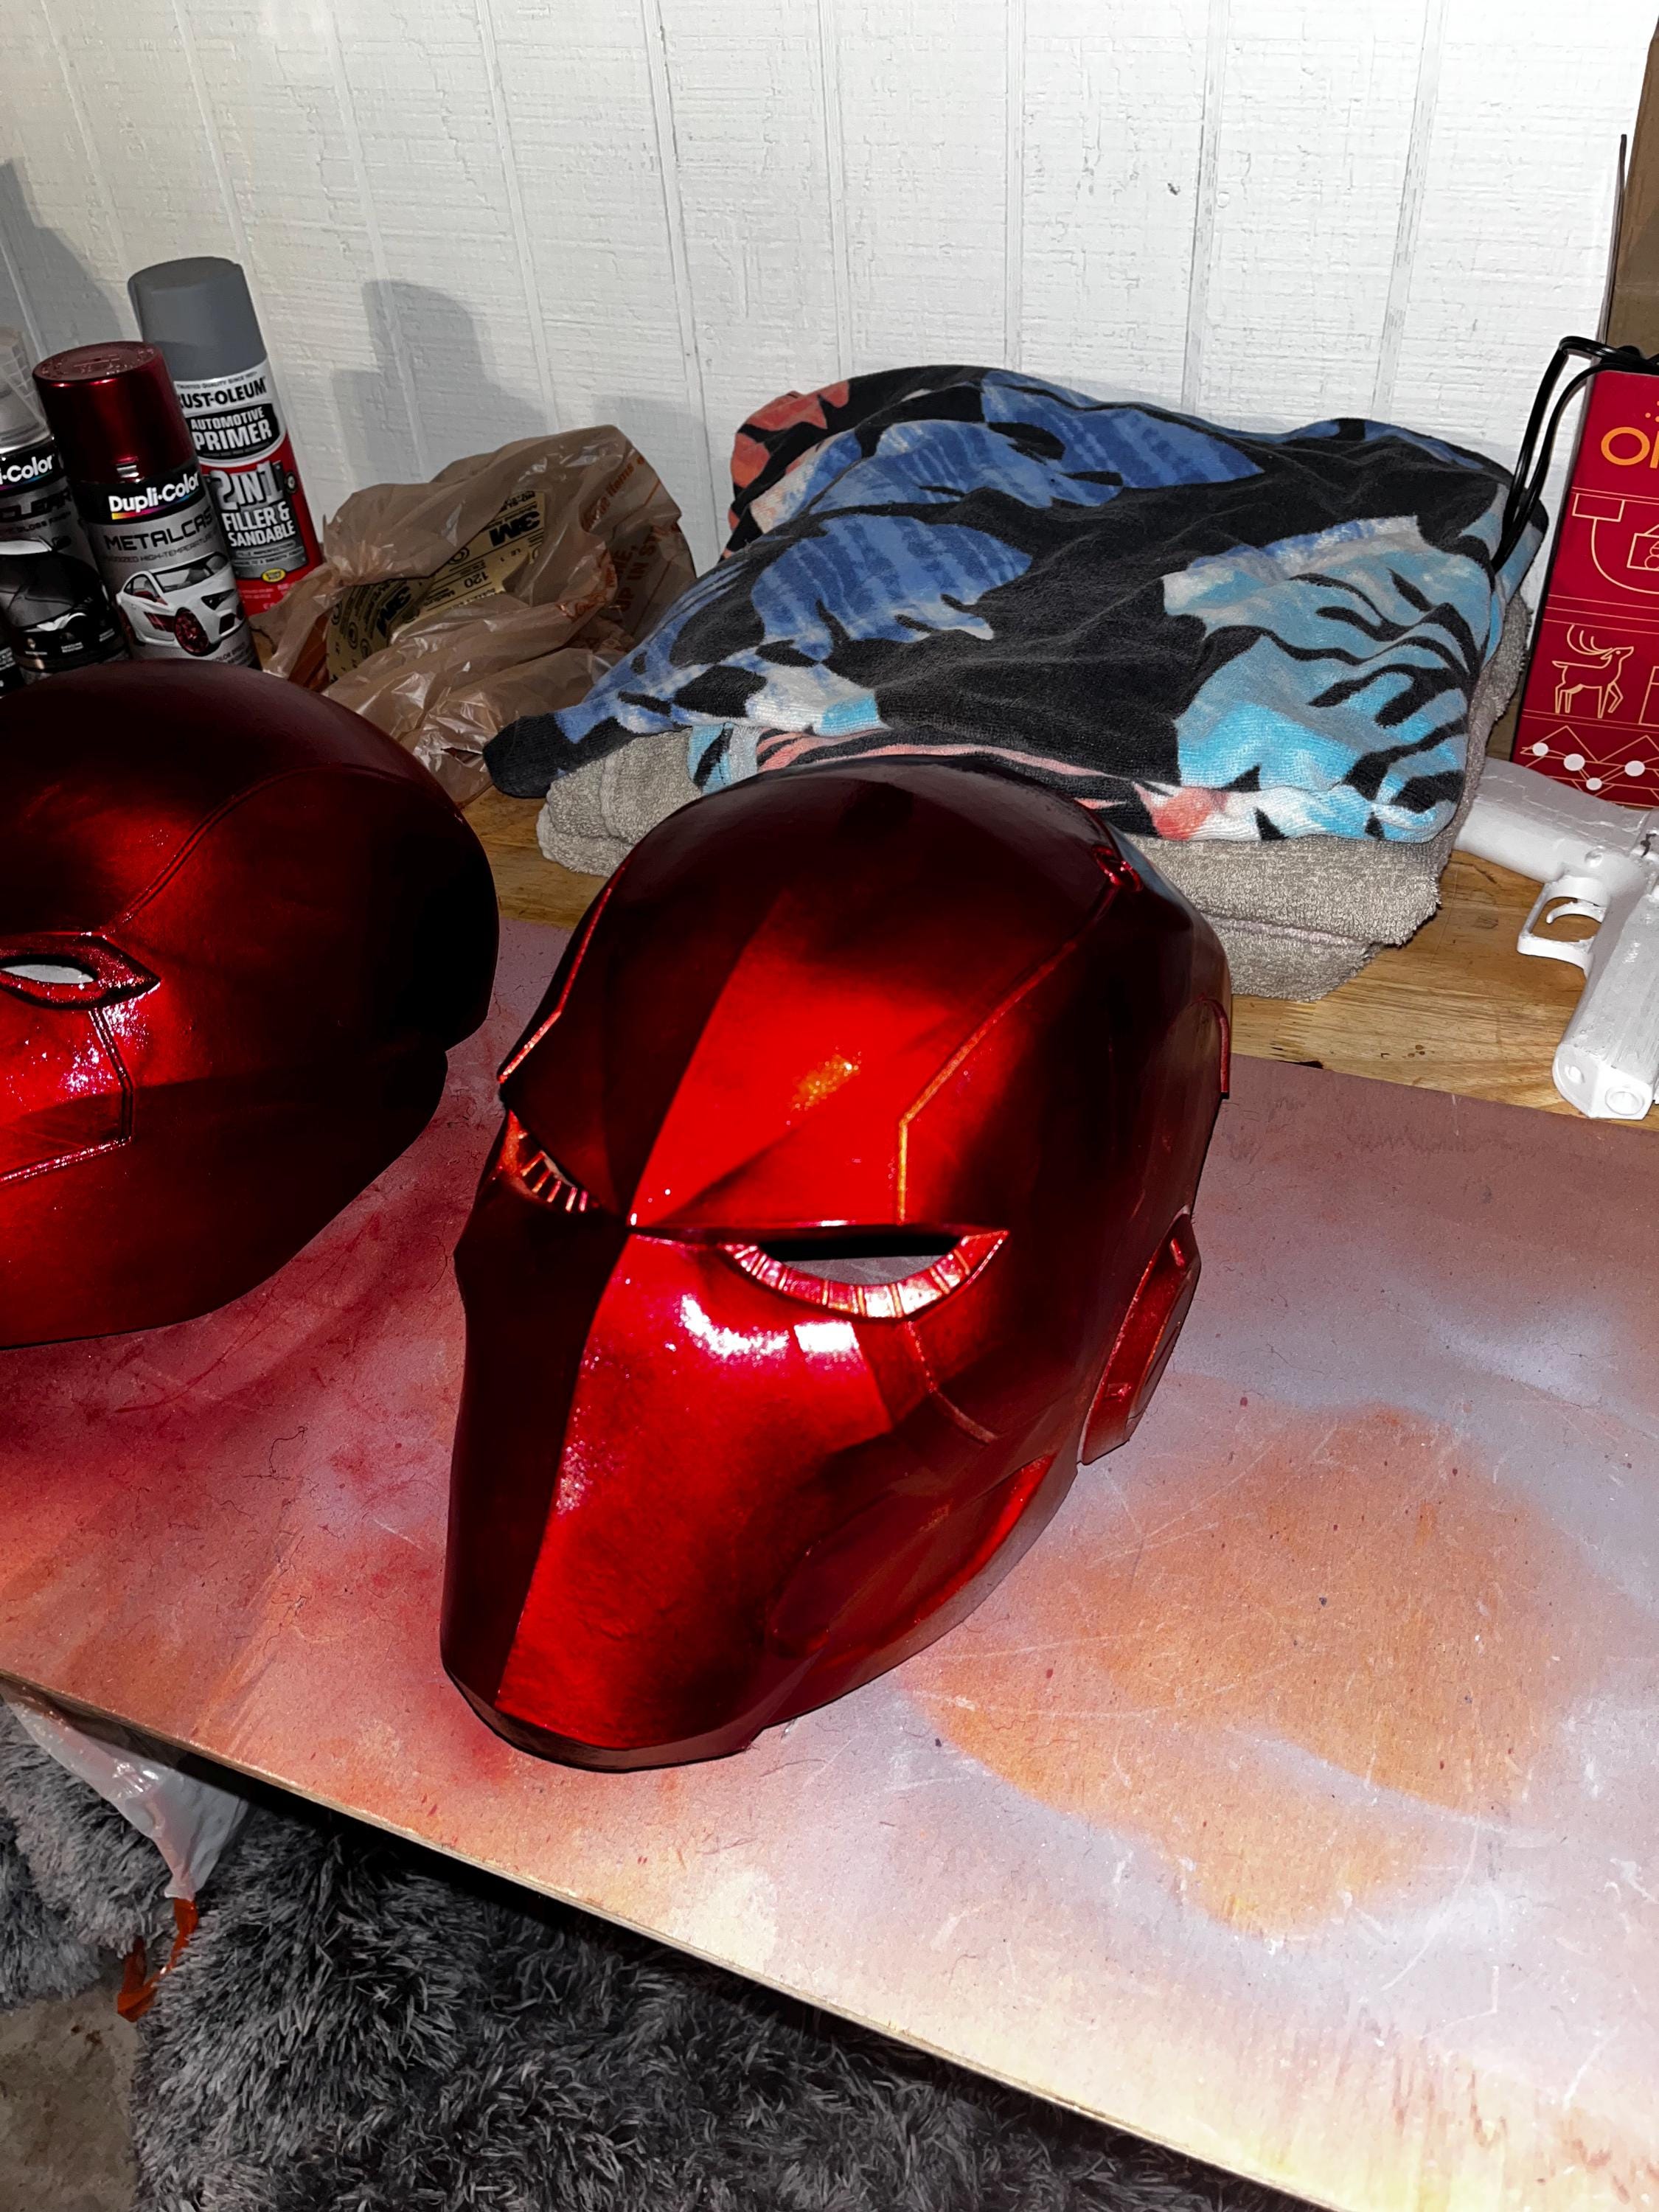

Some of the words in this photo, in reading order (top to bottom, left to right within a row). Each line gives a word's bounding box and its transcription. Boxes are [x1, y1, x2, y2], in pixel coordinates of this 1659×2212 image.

[178, 378, 266, 408] UST-OLEUM
[190, 406, 265, 431] AUTOMOTIVE
[192, 419, 273, 451] PRIMER
[220, 507, 278, 532] FILLER
[277, 501, 291, 521] &
[489, 511, 540, 547] 3M
[226, 521, 297, 548] SANDABLE
[463, 571, 490, 589] 120
[376, 586, 411, 637] 3M
